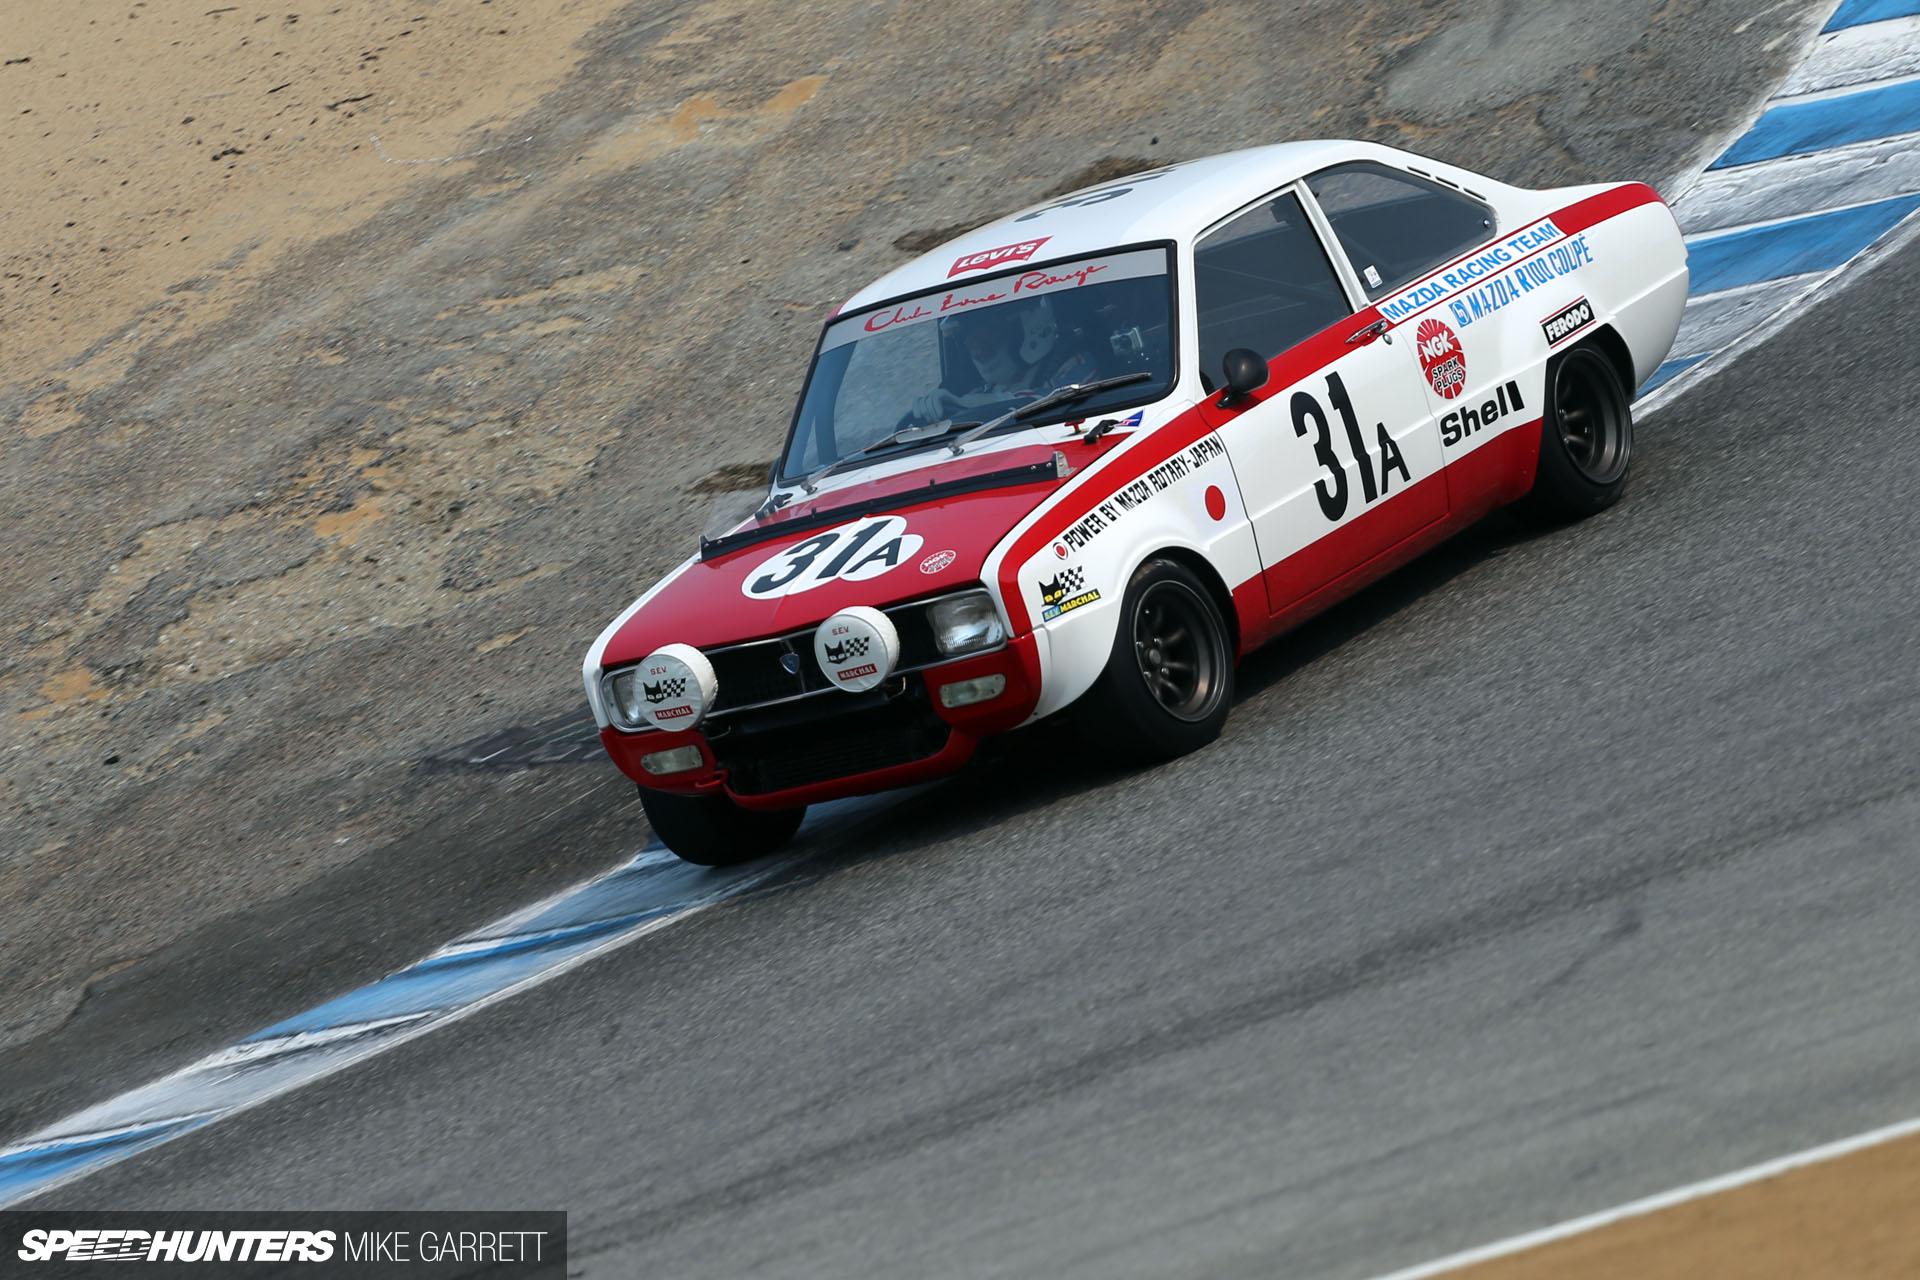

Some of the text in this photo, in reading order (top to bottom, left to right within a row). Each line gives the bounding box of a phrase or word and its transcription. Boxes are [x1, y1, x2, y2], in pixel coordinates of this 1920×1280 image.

[1382, 222, 1560, 320] MAZDA RACING TEAM
[864, 306, 931, 332] Club
[1014, 265, 1108, 293] Rouge
[1466, 275, 1520, 321] MAZDA
[1514, 257, 1555, 293] R100
[1546, 302, 1590, 343] FERODO
[1420, 330, 1454, 363] NGK
[1432, 357, 1460, 379] SPARK
[1436, 369, 1464, 391] PLUGS
[1440, 380, 1525, 447] Shell
[1062, 512, 1108, 552] POWER
[1099, 501, 1121, 522] BY
[1114, 479, 1154, 511] MAZDA
[1060, 590, 1100, 613] MARCHAL
[832, 626, 849, 636] SEV
[650, 666, 667, 675] SEV
[839, 665, 875, 678] MARCHAL
[656, 706, 691, 718] MARCHAL
